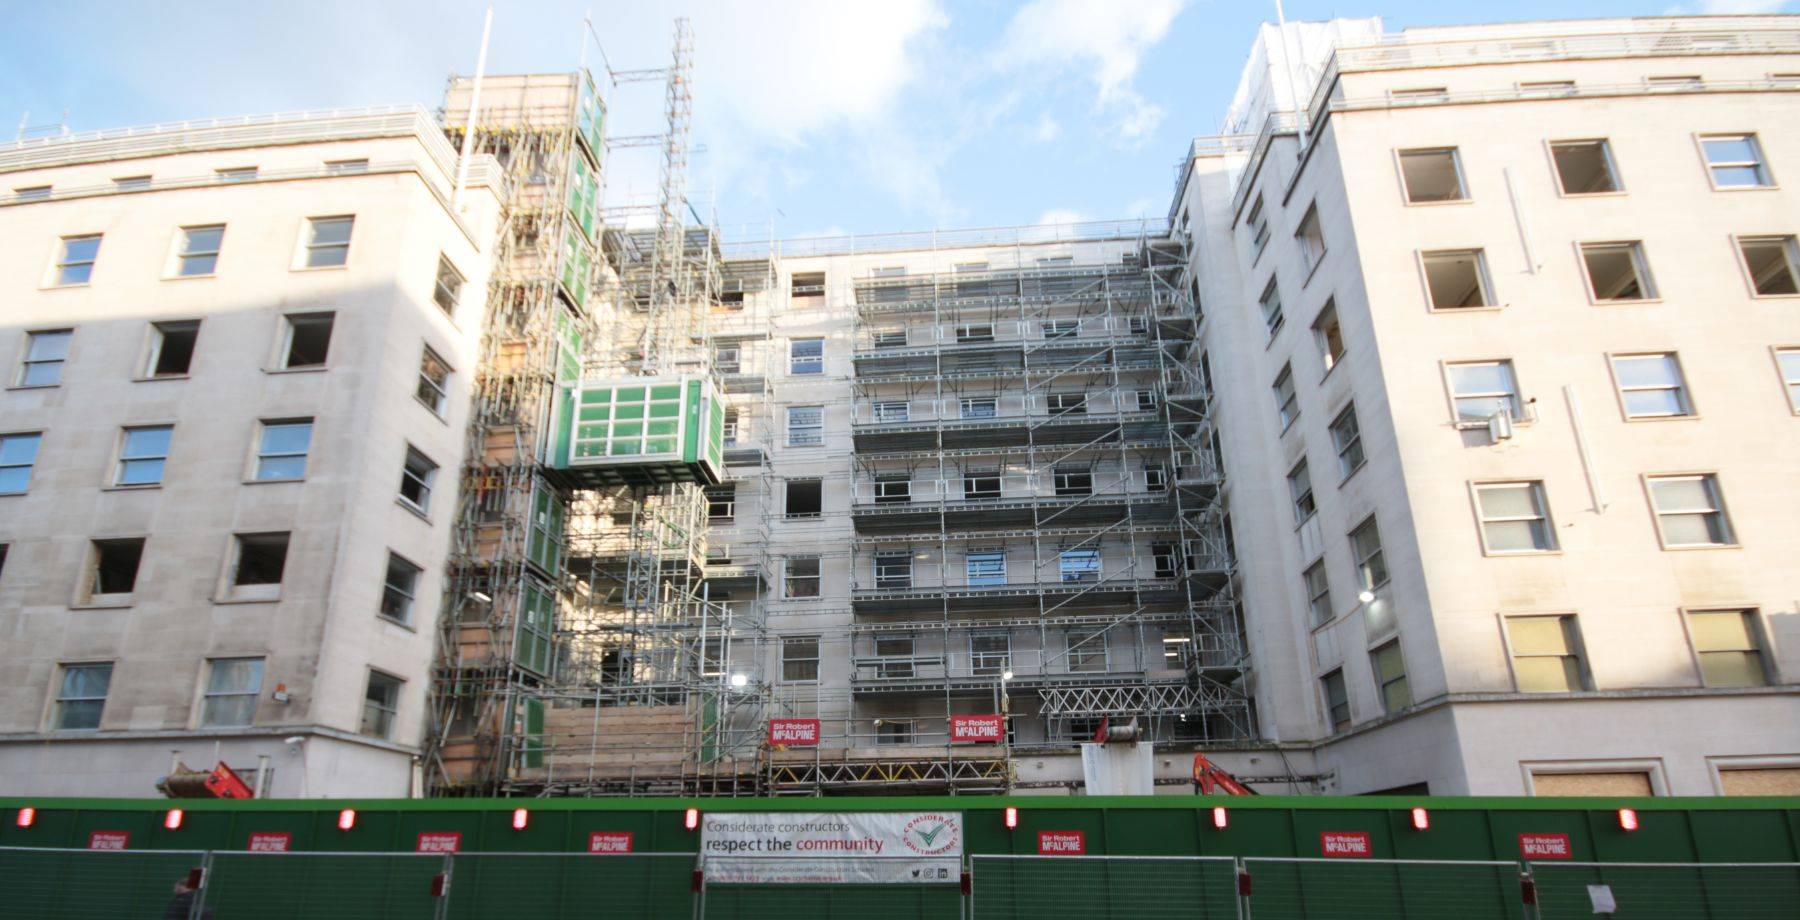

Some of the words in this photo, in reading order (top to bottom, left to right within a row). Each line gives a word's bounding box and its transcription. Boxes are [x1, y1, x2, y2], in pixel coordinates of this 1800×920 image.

[706, 820, 775, 833] Considerate
[778, 821, 850, 833] constructors
[903, 814, 959, 833] CONSIDERATE
[706, 838, 763, 854] respect
[767, 837, 792, 851] the
[796, 836, 884, 854] community
[903, 836, 958, 855] CONSTRUCTORS
